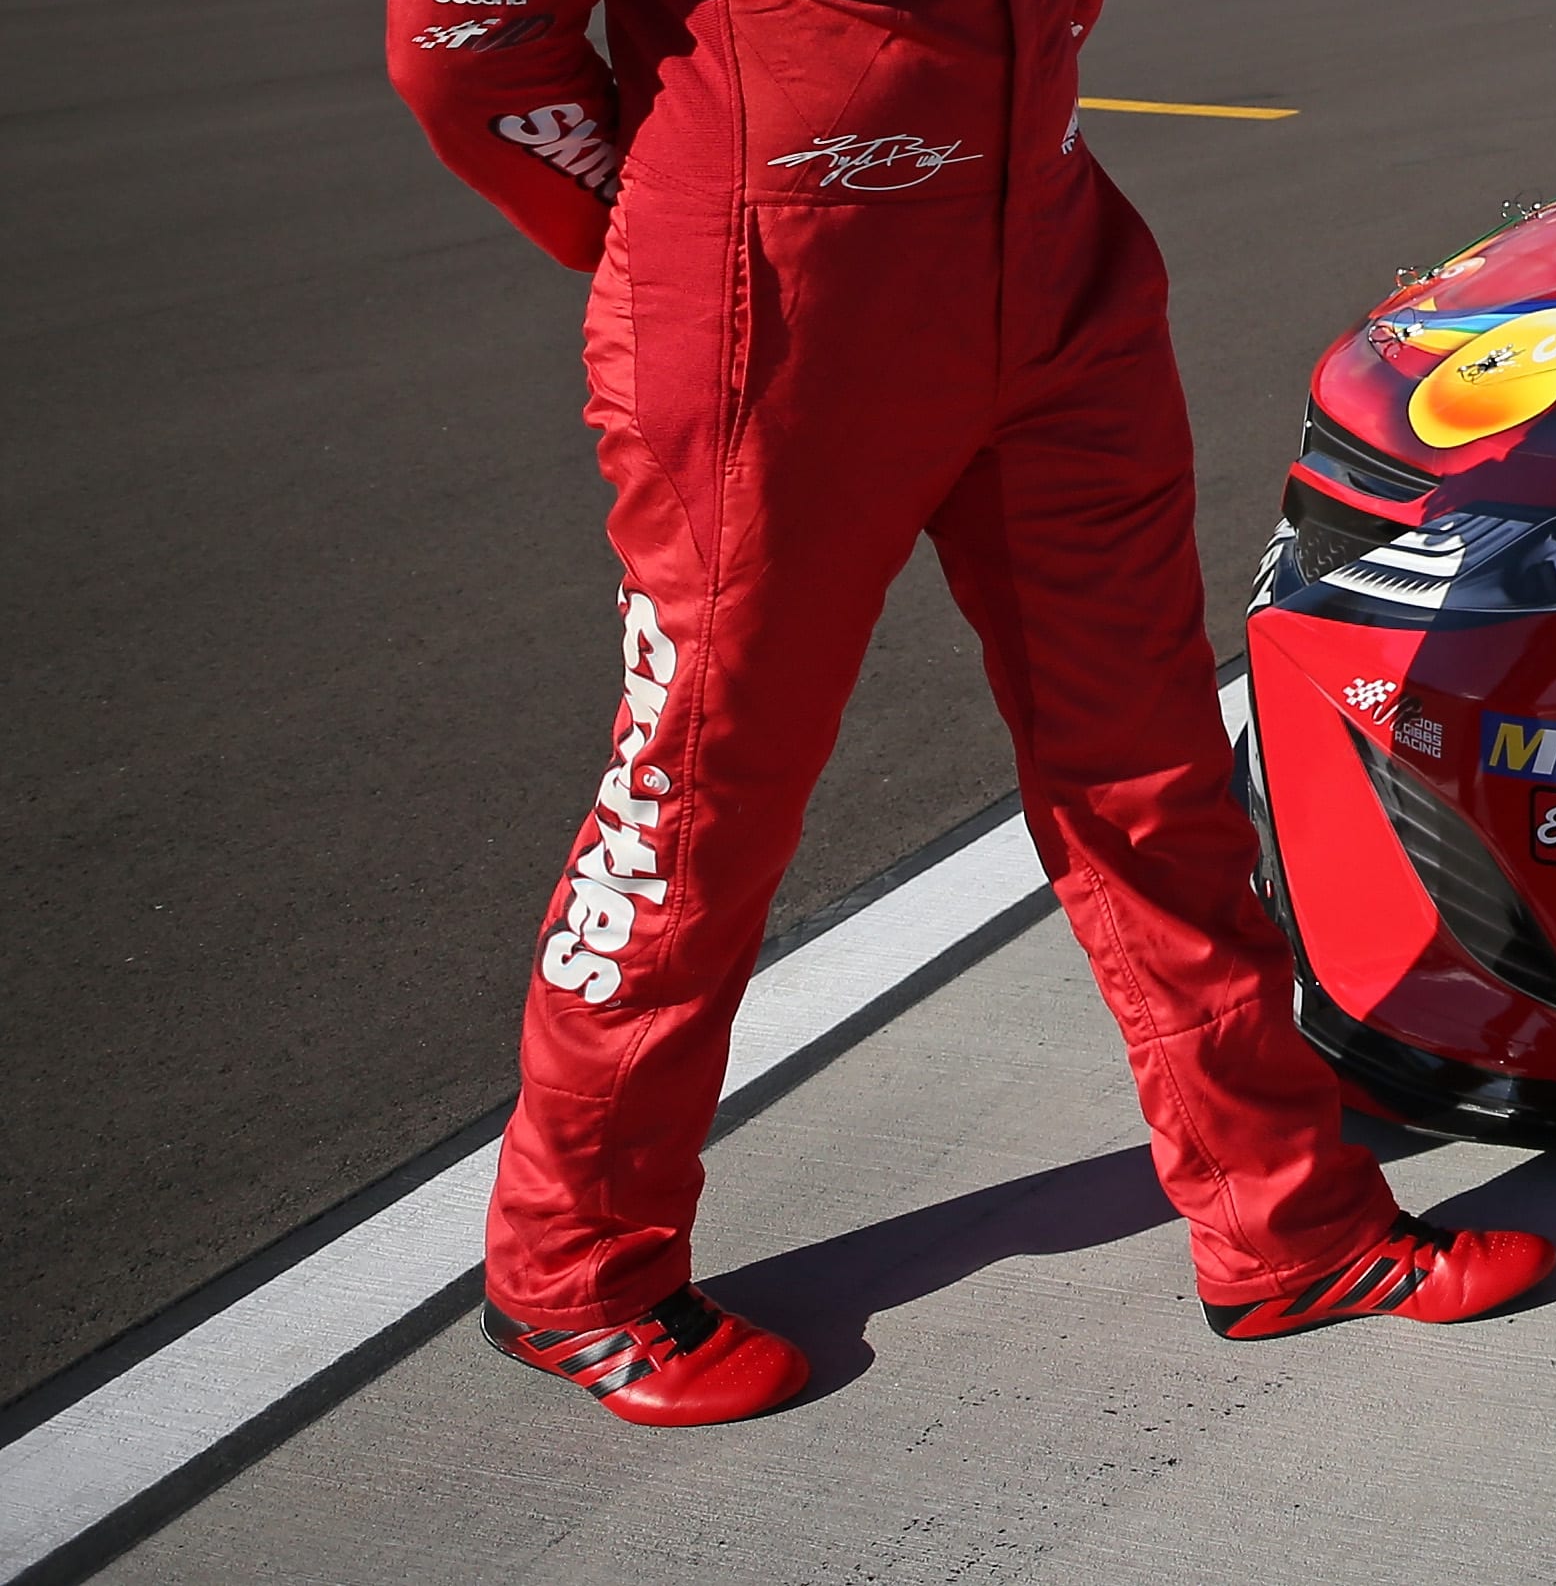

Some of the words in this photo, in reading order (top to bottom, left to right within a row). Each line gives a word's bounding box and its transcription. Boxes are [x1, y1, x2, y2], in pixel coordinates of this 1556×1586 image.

[1403, 722, 1442, 747] GIBBS
[1411, 717, 1443, 736] JOE
[1394, 730, 1442, 759] RACING
[540, 588, 678, 1005] Skittles
